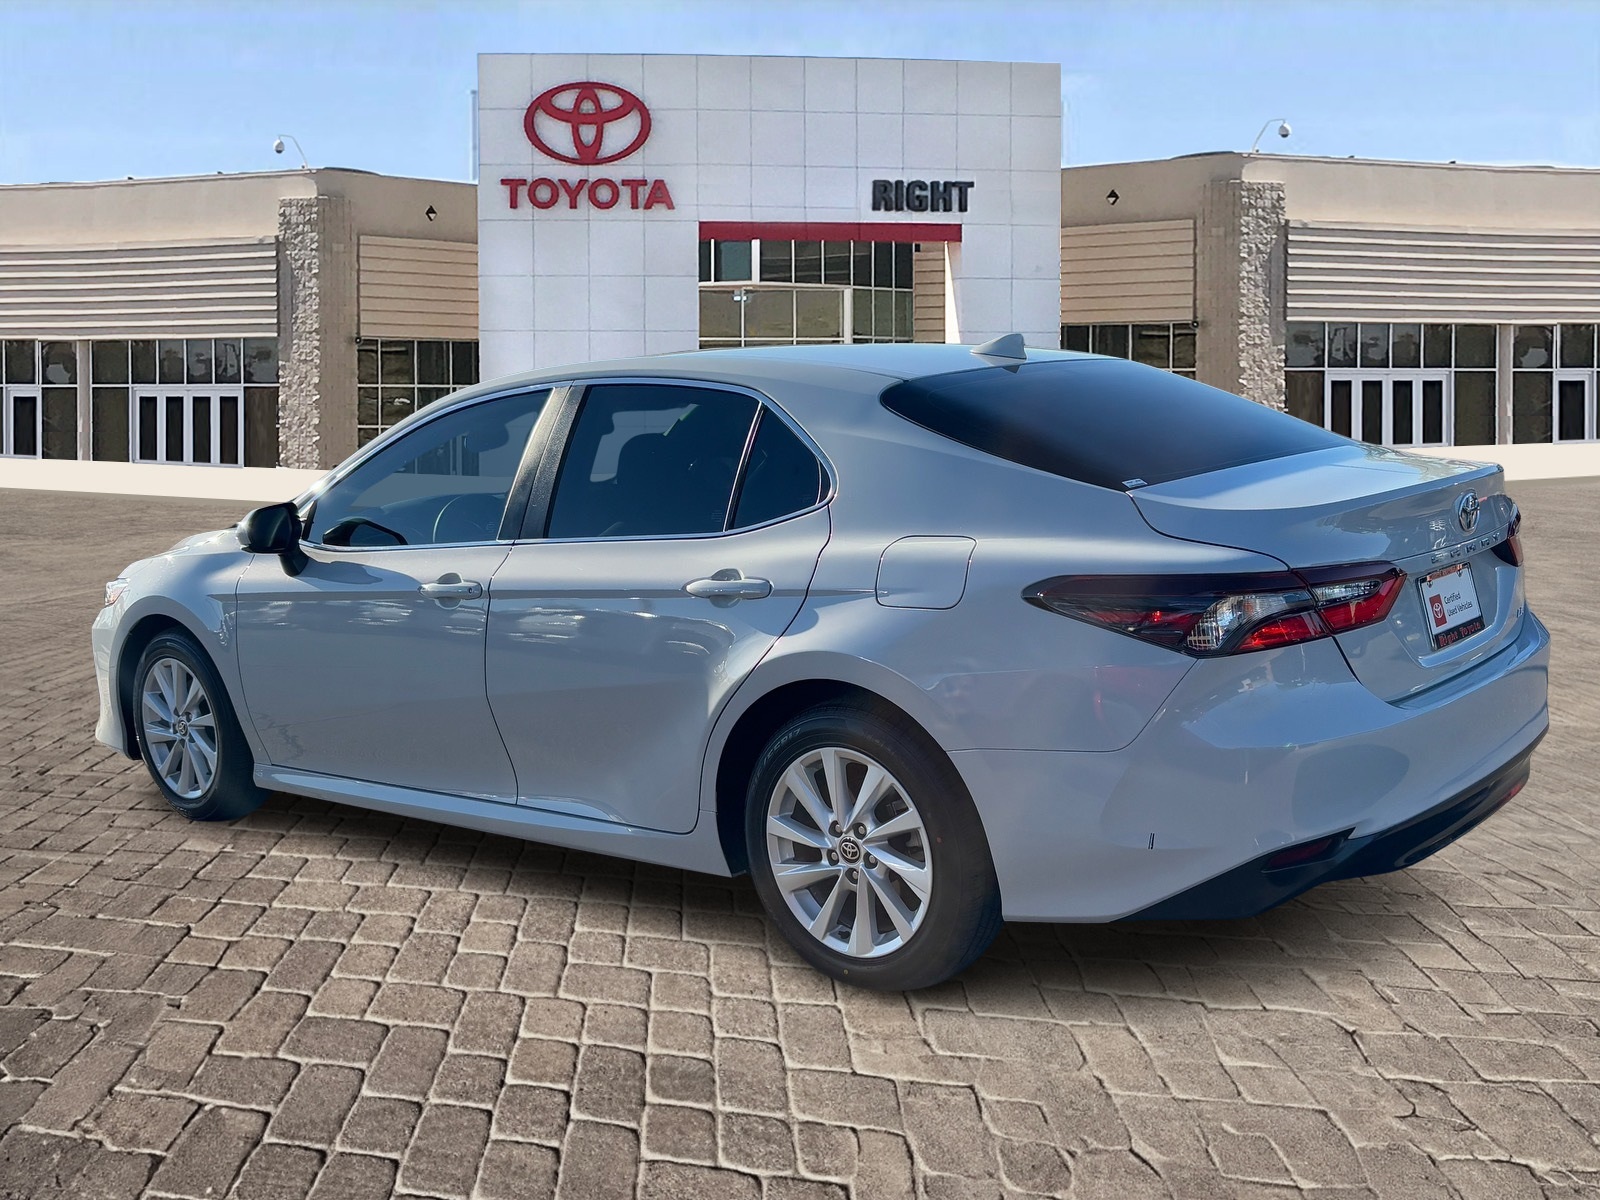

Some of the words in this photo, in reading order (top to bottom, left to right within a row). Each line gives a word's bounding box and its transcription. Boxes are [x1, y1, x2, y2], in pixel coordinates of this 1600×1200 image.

[500, 178, 675, 210] TOYOTA
[871, 179, 976, 212] RIGHT
[1443, 592, 1461, 604] Certified
[1457, 601, 1473, 614] Vehicles
[1438, 631, 1458, 647] Right
[1459, 621, 1481, 638] Toyota
